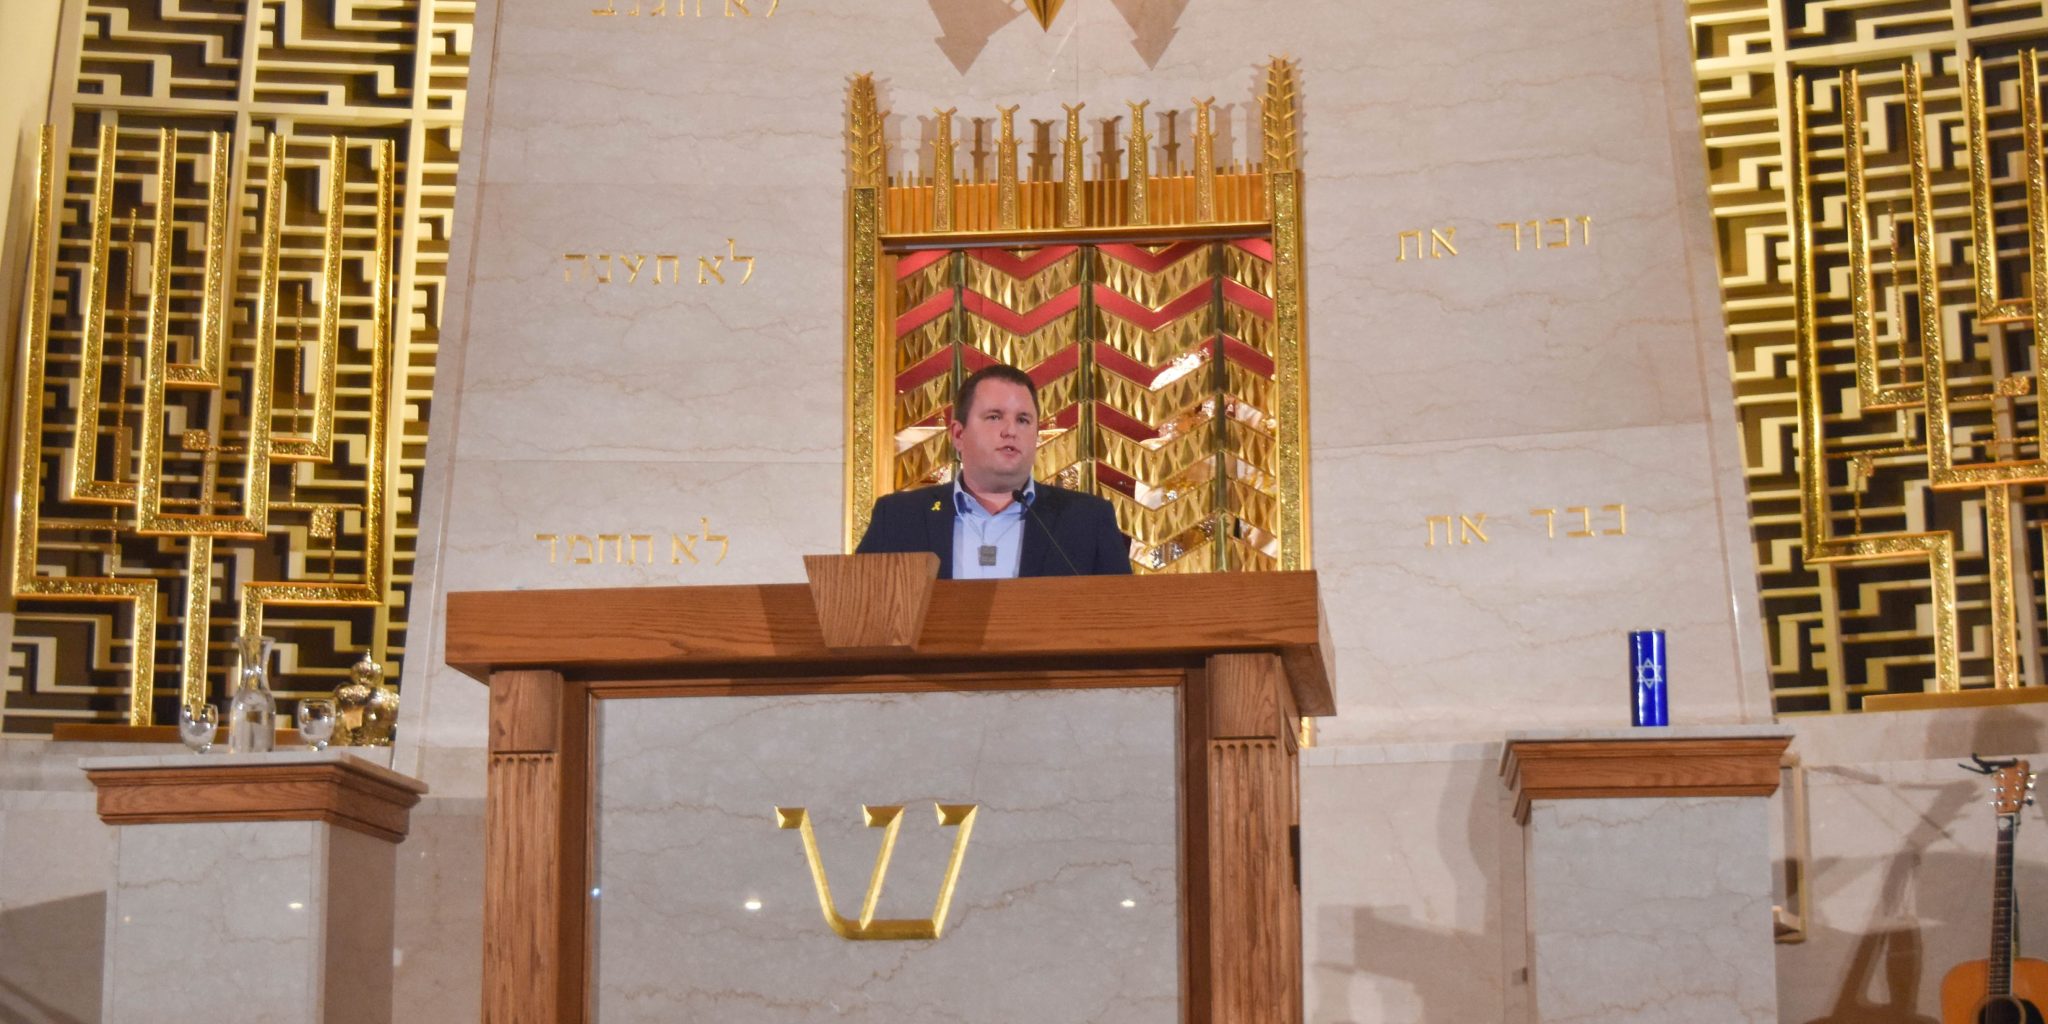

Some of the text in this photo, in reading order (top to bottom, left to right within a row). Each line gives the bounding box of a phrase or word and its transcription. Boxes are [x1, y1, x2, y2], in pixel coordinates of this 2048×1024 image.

[562, 238, 757, 286] לא תצנה
[1396, 215, 1592, 262] זכור את
[533, 516, 730, 567] לא תחמד
[1424, 503, 1627, 549] כבד את
[774, 801, 979, 942] ש
